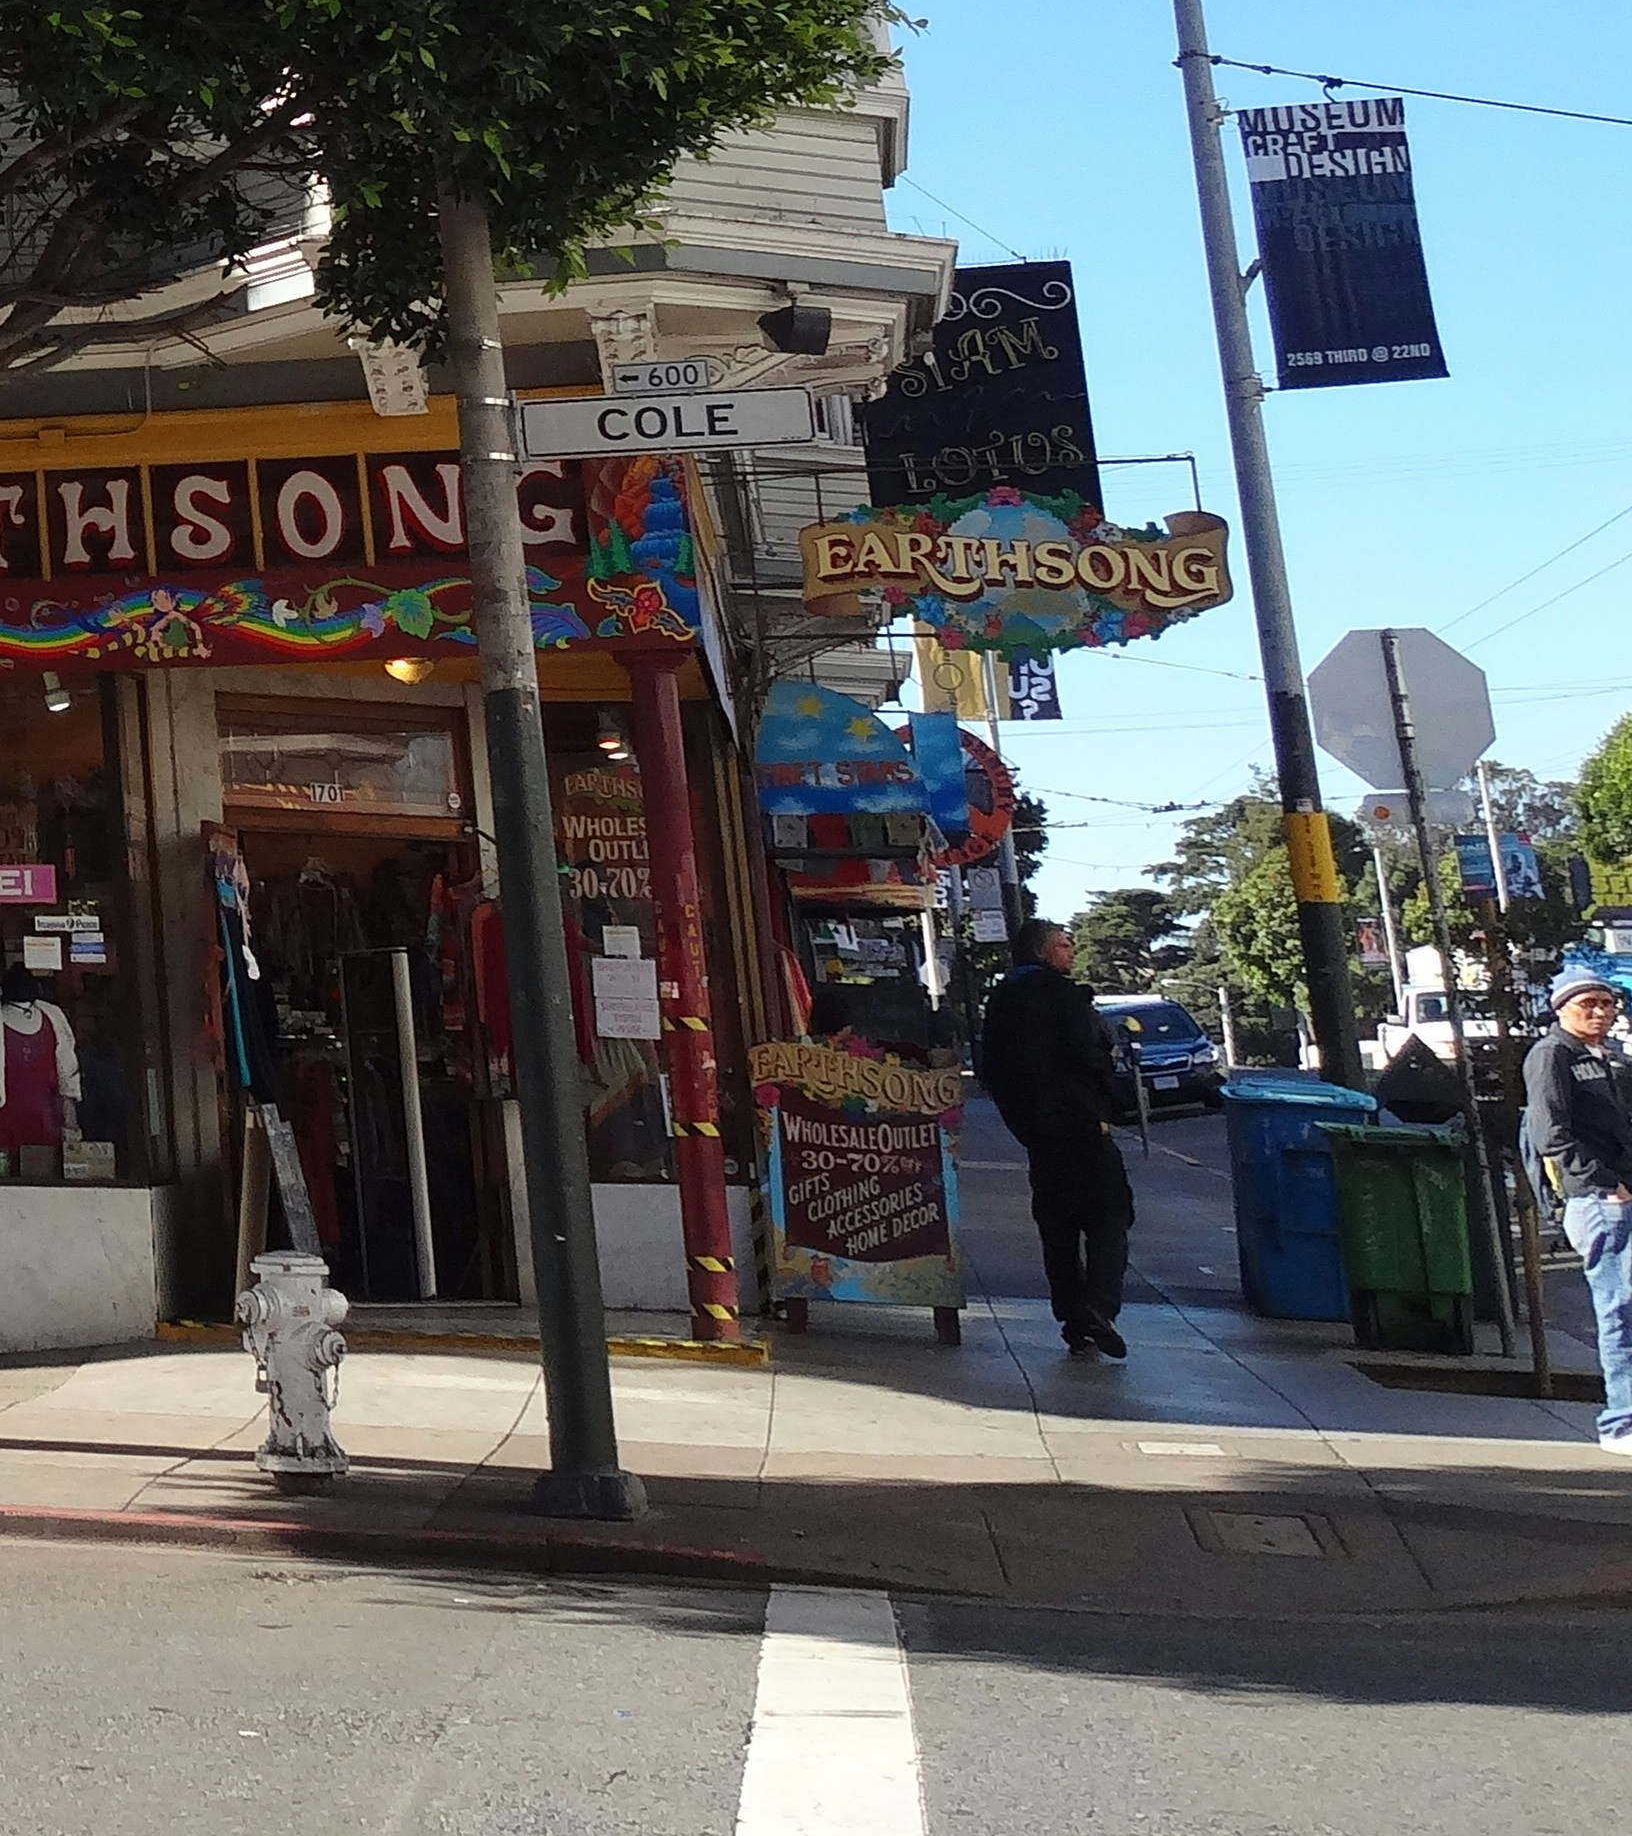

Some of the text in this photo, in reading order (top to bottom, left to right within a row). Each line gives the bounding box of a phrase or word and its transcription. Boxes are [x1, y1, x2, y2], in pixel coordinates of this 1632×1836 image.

[1239, 97, 1405, 133] MUSEUM
[1246, 131, 1337, 158] CRAFT
[1286, 146, 1408, 179] DESIGN
[1287, 343, 1431, 367] 2569 THIRD @ 22ND
[648, 363, 699, 387] 600
[597, 403, 739, 441] COLE
[898, 424, 1089, 494] LOTUS
[814, 531, 1220, 609] EARTHSONG
[310, 782, 345, 801] 1701
[752, 1042, 960, 1115] EARTHSONG
[782, 1111, 939, 1152] WHOLESALE OUTLET
[801, 1150, 900, 1174] 30-70%
[788, 1172, 831, 1206] GIFTS
[807, 1175, 881, 1222] CLOTHING
[826, 1182, 923, 1239] ACCESSORIES
[845, 1201, 939, 1256] HOME DECOR
